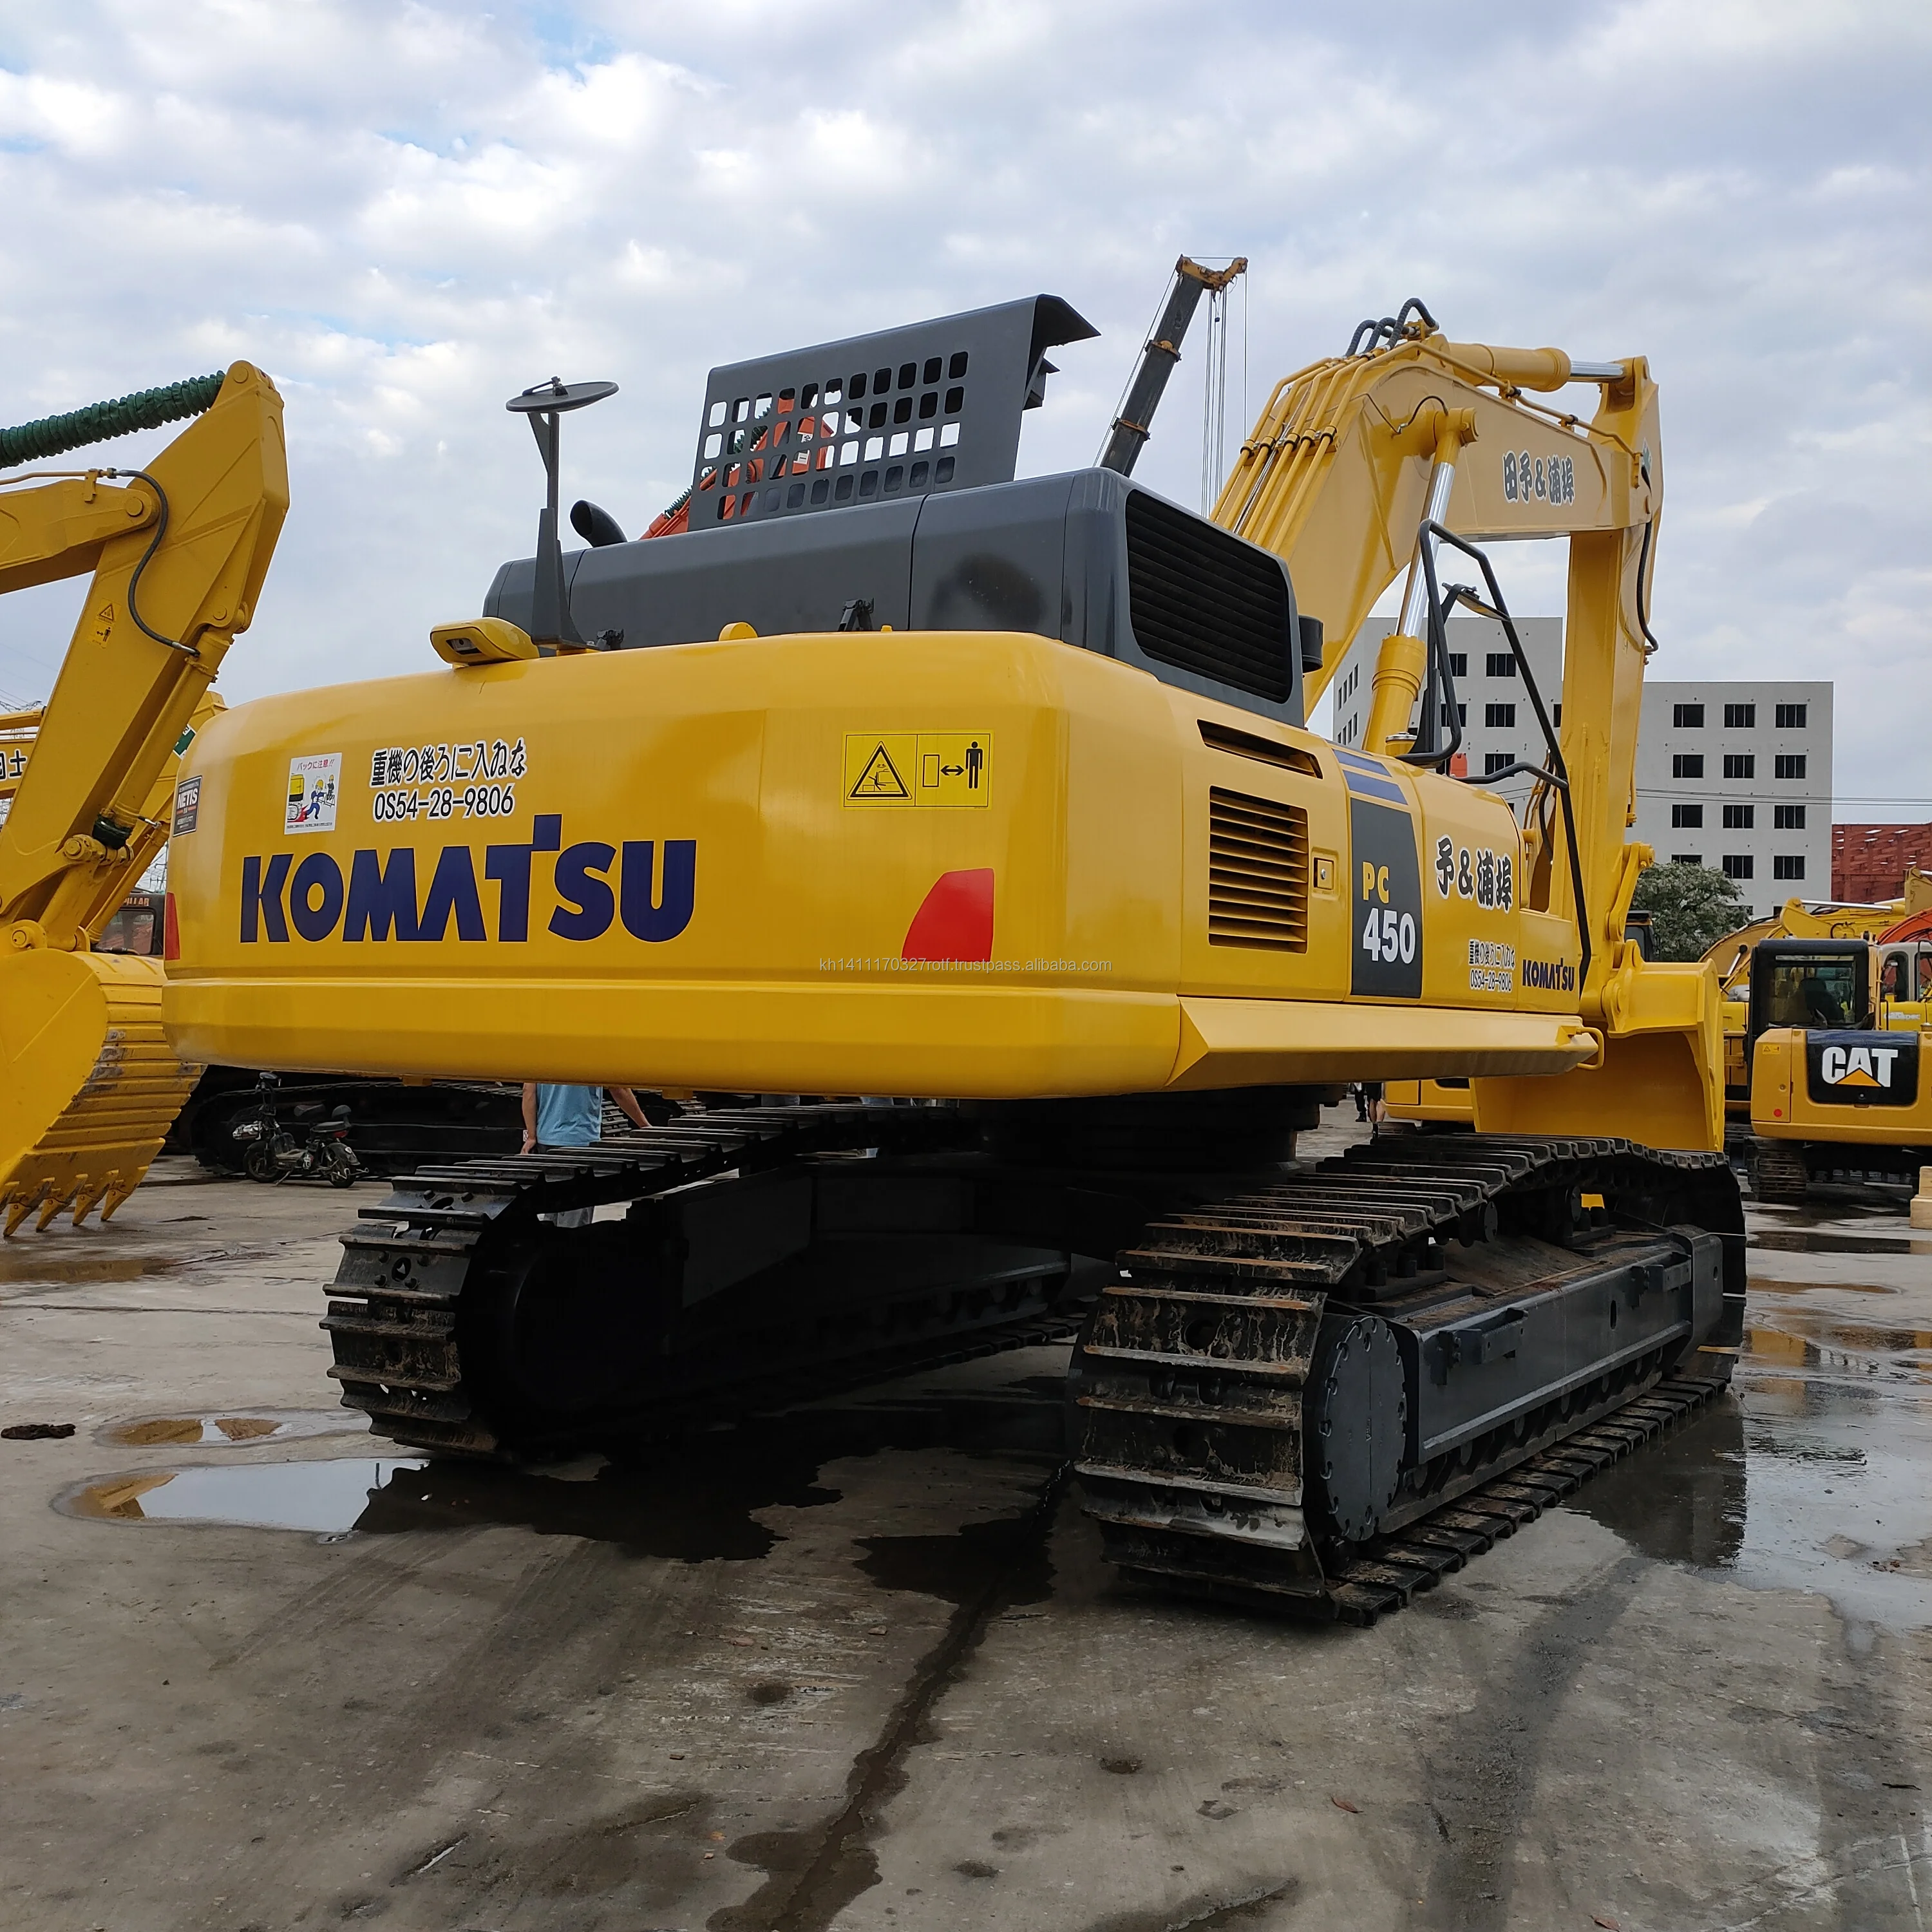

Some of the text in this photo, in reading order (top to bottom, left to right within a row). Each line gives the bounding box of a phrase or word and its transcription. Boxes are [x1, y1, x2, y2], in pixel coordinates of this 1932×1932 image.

[177, 788, 198, 810] NETIS
[240, 814, 696, 942] KOMATSU
[1363, 861, 1389, 904] PC
[1363, 907, 1416, 964] 450
[1522, 957, 1575, 992] KOMATSU
[1822, 1046, 1899, 1088] CAT
